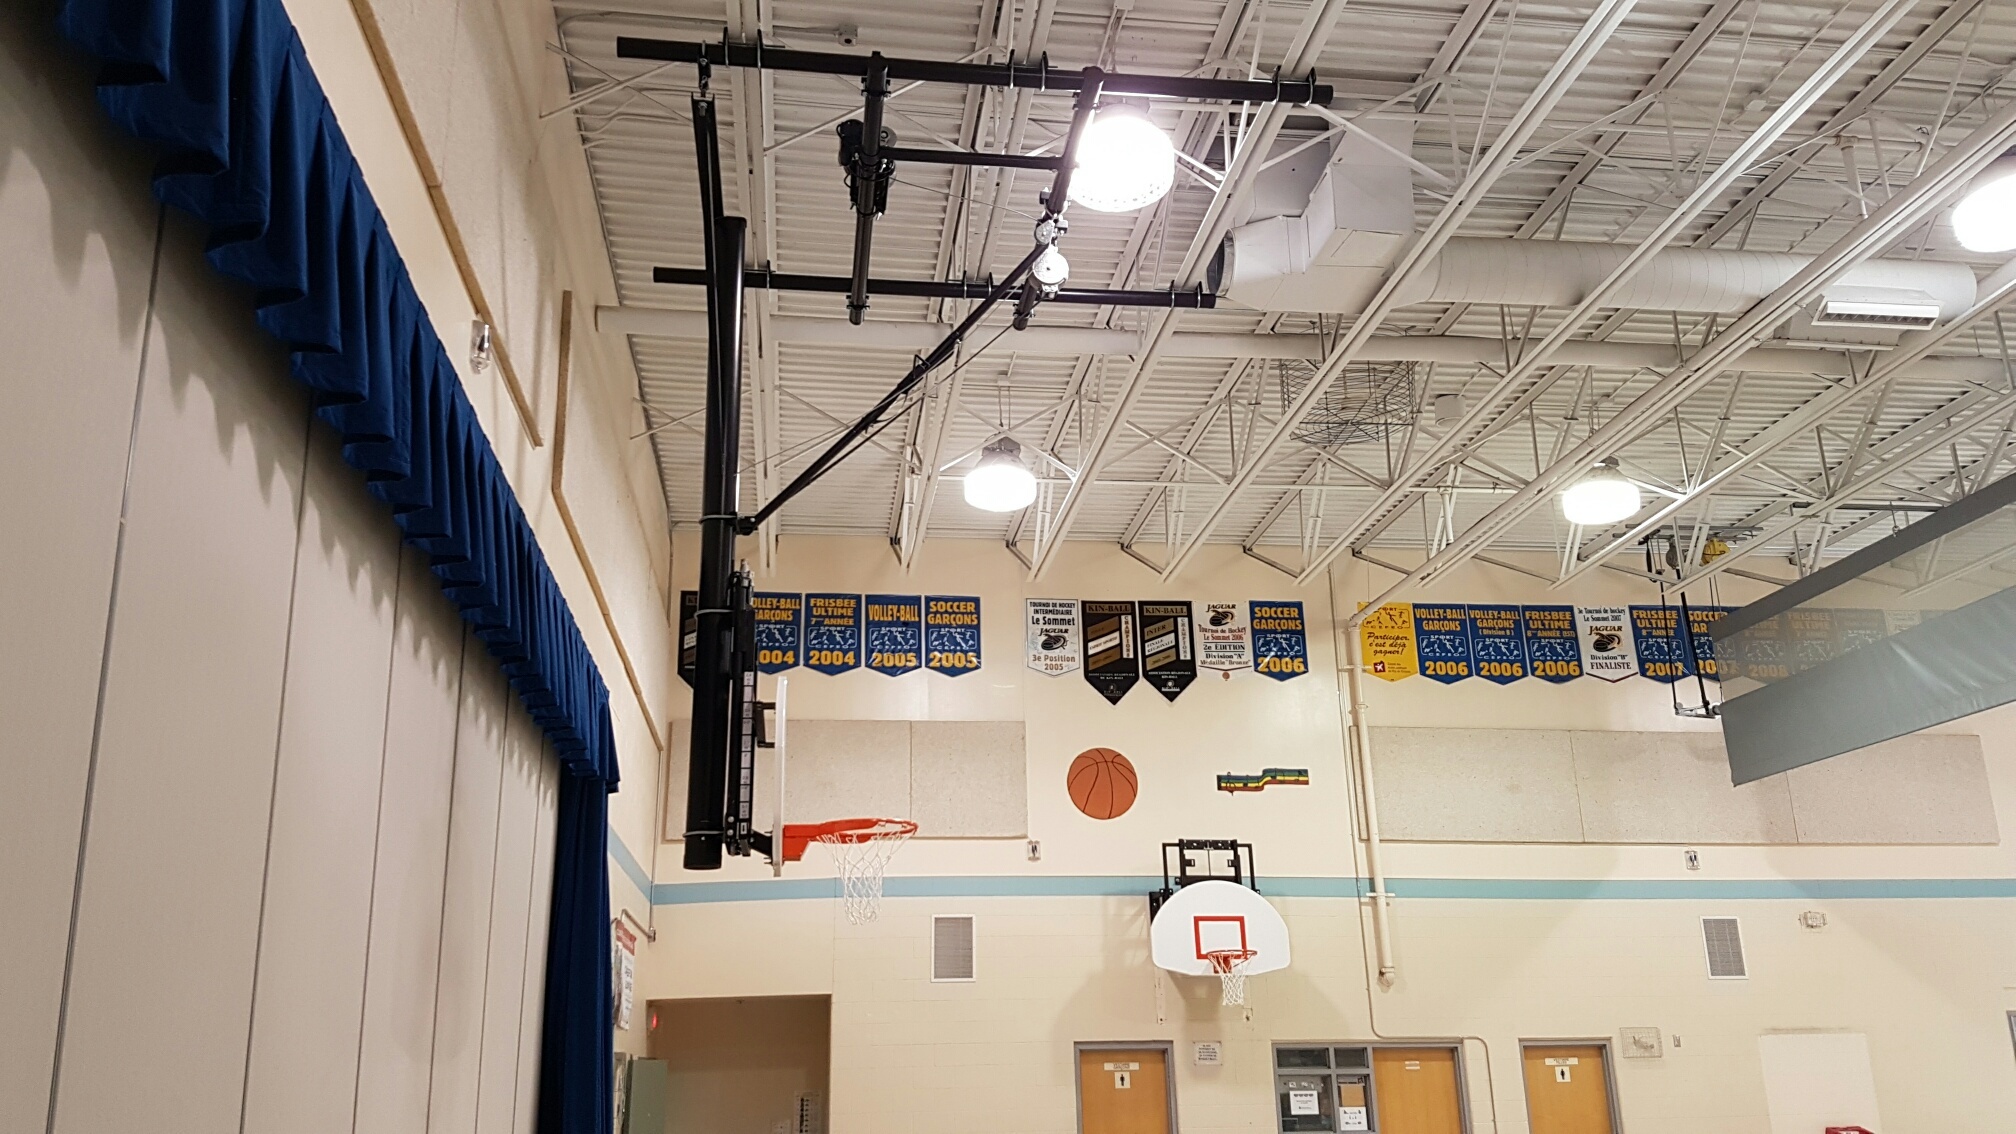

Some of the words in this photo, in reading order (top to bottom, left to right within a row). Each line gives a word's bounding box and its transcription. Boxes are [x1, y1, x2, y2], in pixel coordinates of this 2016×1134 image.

[752, 598, 800, 610] OLLEY-BALL
[810, 598, 857, 608] FRISBEE
[929, 601, 976, 612] SOCCER
[1088, 604, 1130, 612] KIN-BALL
[1205, 604, 1236, 612] JAGUAR
[813, 607, 854, 616] ULTIME
[868, 604, 919, 621] VOLLEY-BALL
[1145, 606, 1186, 614] KIN-BALL
[1254, 607, 1299, 617] SOCCER
[1414, 608, 1466, 619] VOLLEY-BALL
[1469, 610, 1520, 620] VOLLEY-BALL
[1633, 610, 1678, 619] FRISBEE
[927, 613, 978, 627] GARÇONS
[1525, 611, 1572, 620] FRISBEE
[824, 617, 854, 626] ANNÉE
[1031, 616, 1040, 625] Le
[1042, 616, 1075, 626] Sommet
[1253, 619, 1302, 631] GARÇONS
[1422, 620, 1461, 632] GARÇONS
[1476, 619, 1514, 629] GARÇONS
[1529, 620, 1571, 629] ULTIME
[1038, 628, 1069, 636] JAGUAR
[1146, 624, 1166, 636] INTER
[1588, 625, 1623, 635] JAGUAR
[759, 650, 795, 665] 004
[808, 650, 856, 666] 2004
[871, 652, 917, 667] 2005
[929, 652, 977, 668] 2005
[1044, 654, 1075, 662] Position
[1044, 663, 1063, 671] 2005
[1257, 658, 1306, 673] 2006
[1425, 661, 1469, 675] 2006
[1480, 661, 1523, 677] 2006
[1533, 661, 1580, 676] 2006
[1590, 662, 1632, 670] FINALISTE
[1645, 662, 1684, 677] 2007
